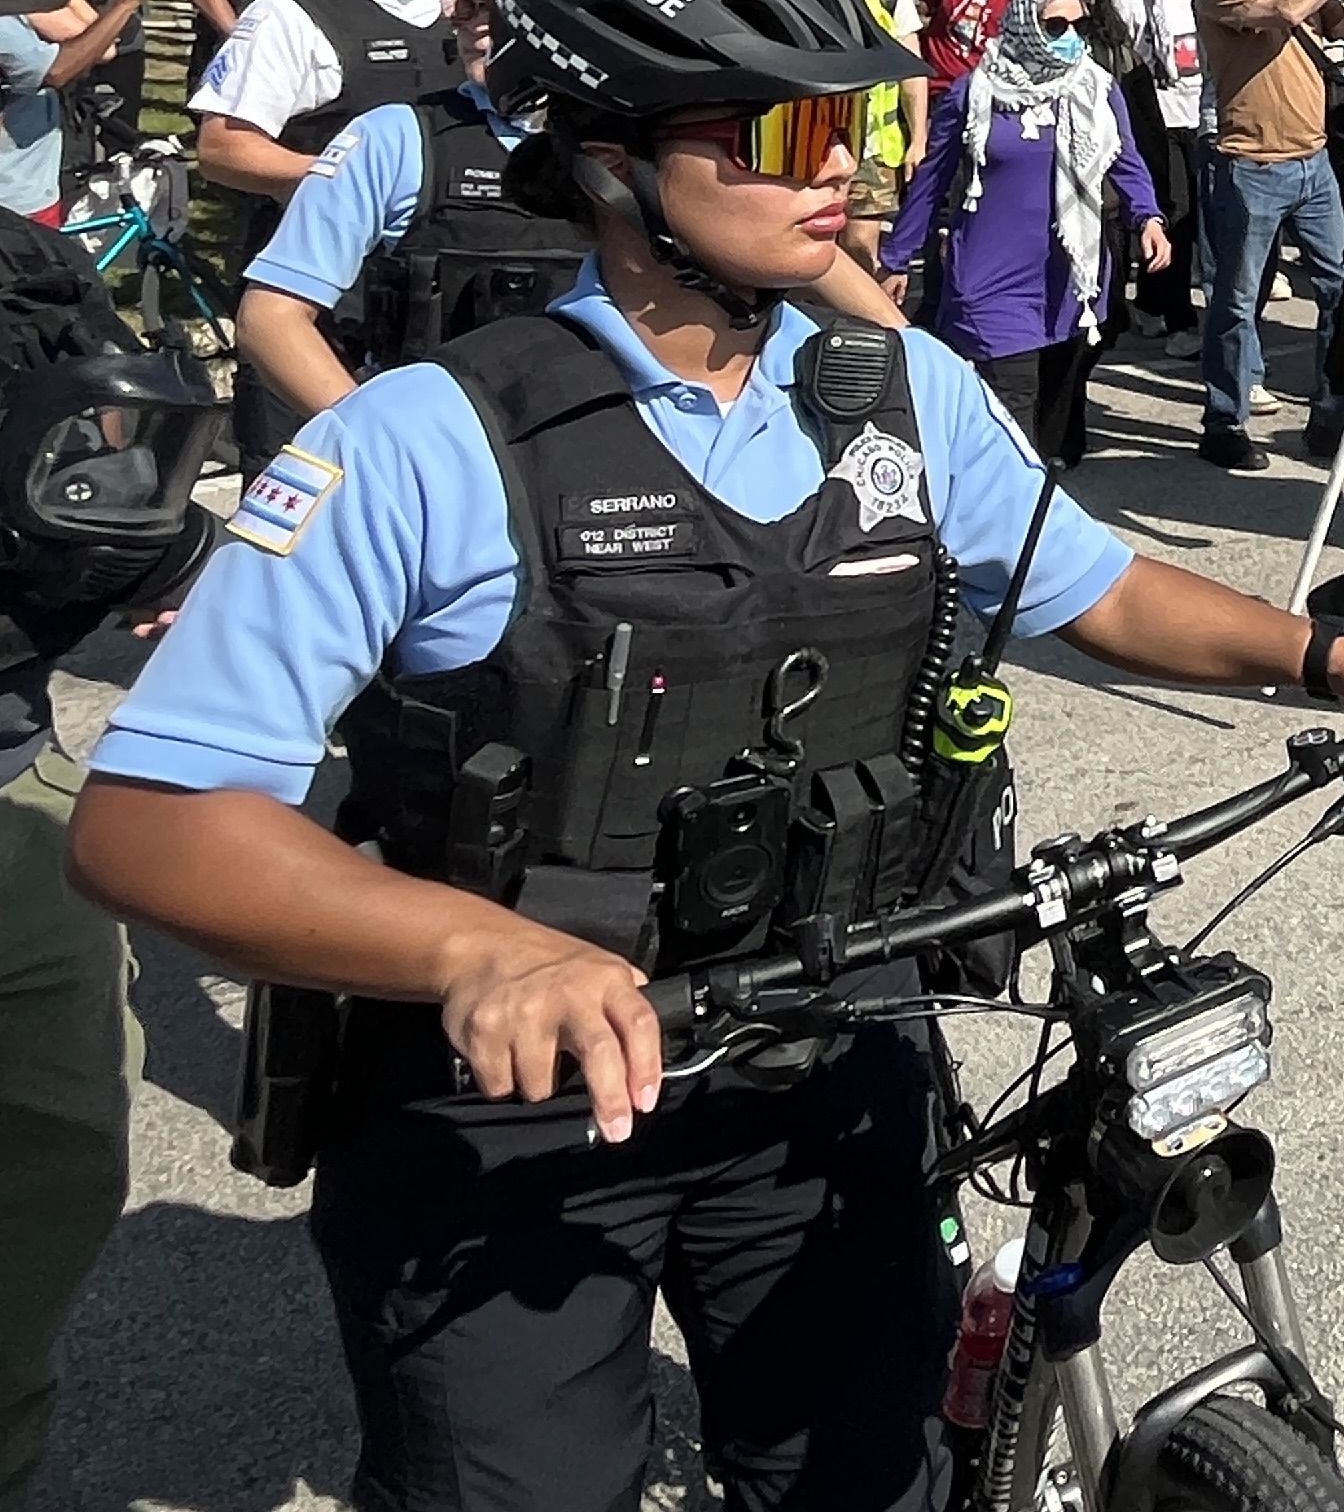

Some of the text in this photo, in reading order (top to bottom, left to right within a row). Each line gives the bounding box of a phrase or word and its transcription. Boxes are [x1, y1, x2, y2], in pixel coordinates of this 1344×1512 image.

[590, 494, 676, 514] SERRANO
[580, 524, 677, 542] 012 DISTRICT
[584, 538, 674, 555] NEAR WEST
